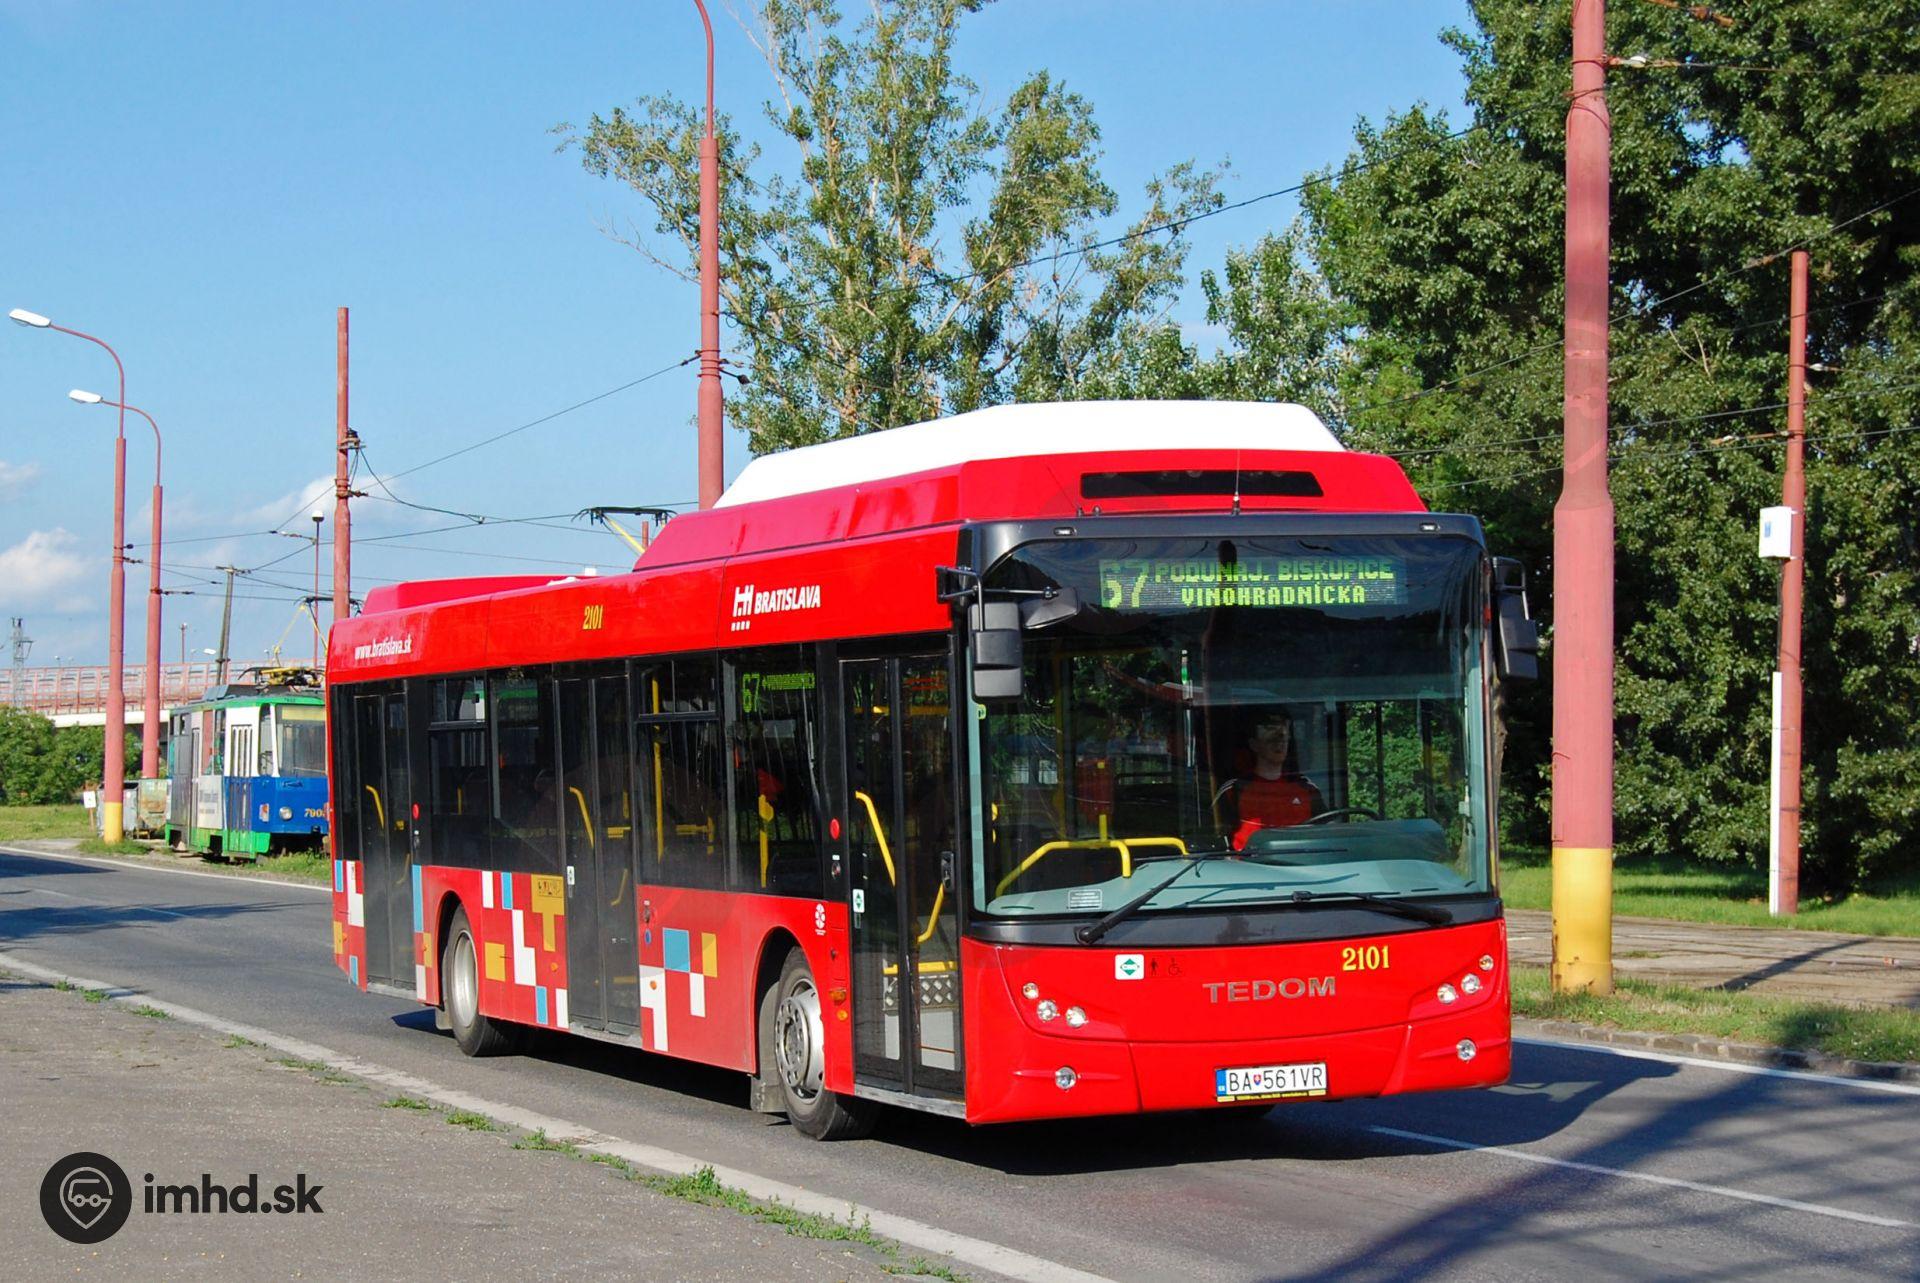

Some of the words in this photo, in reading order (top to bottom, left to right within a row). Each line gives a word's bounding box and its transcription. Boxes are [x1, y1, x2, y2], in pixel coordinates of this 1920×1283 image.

[1278, 559, 1394, 581] BISKUPICE
[754, 585, 821, 614] BRATISLAVA
[583, 605, 603, 629] 2101
[354, 633, 412, 660] www.bratislava.sk
[743, 673, 760, 712] 67
[1342, 946, 1390, 971] 2101
[1203, 976, 1336, 1004] TEDOM
[1229, 1072, 1252, 1091] BA
[1263, 1067, 1323, 1089] 561VR
